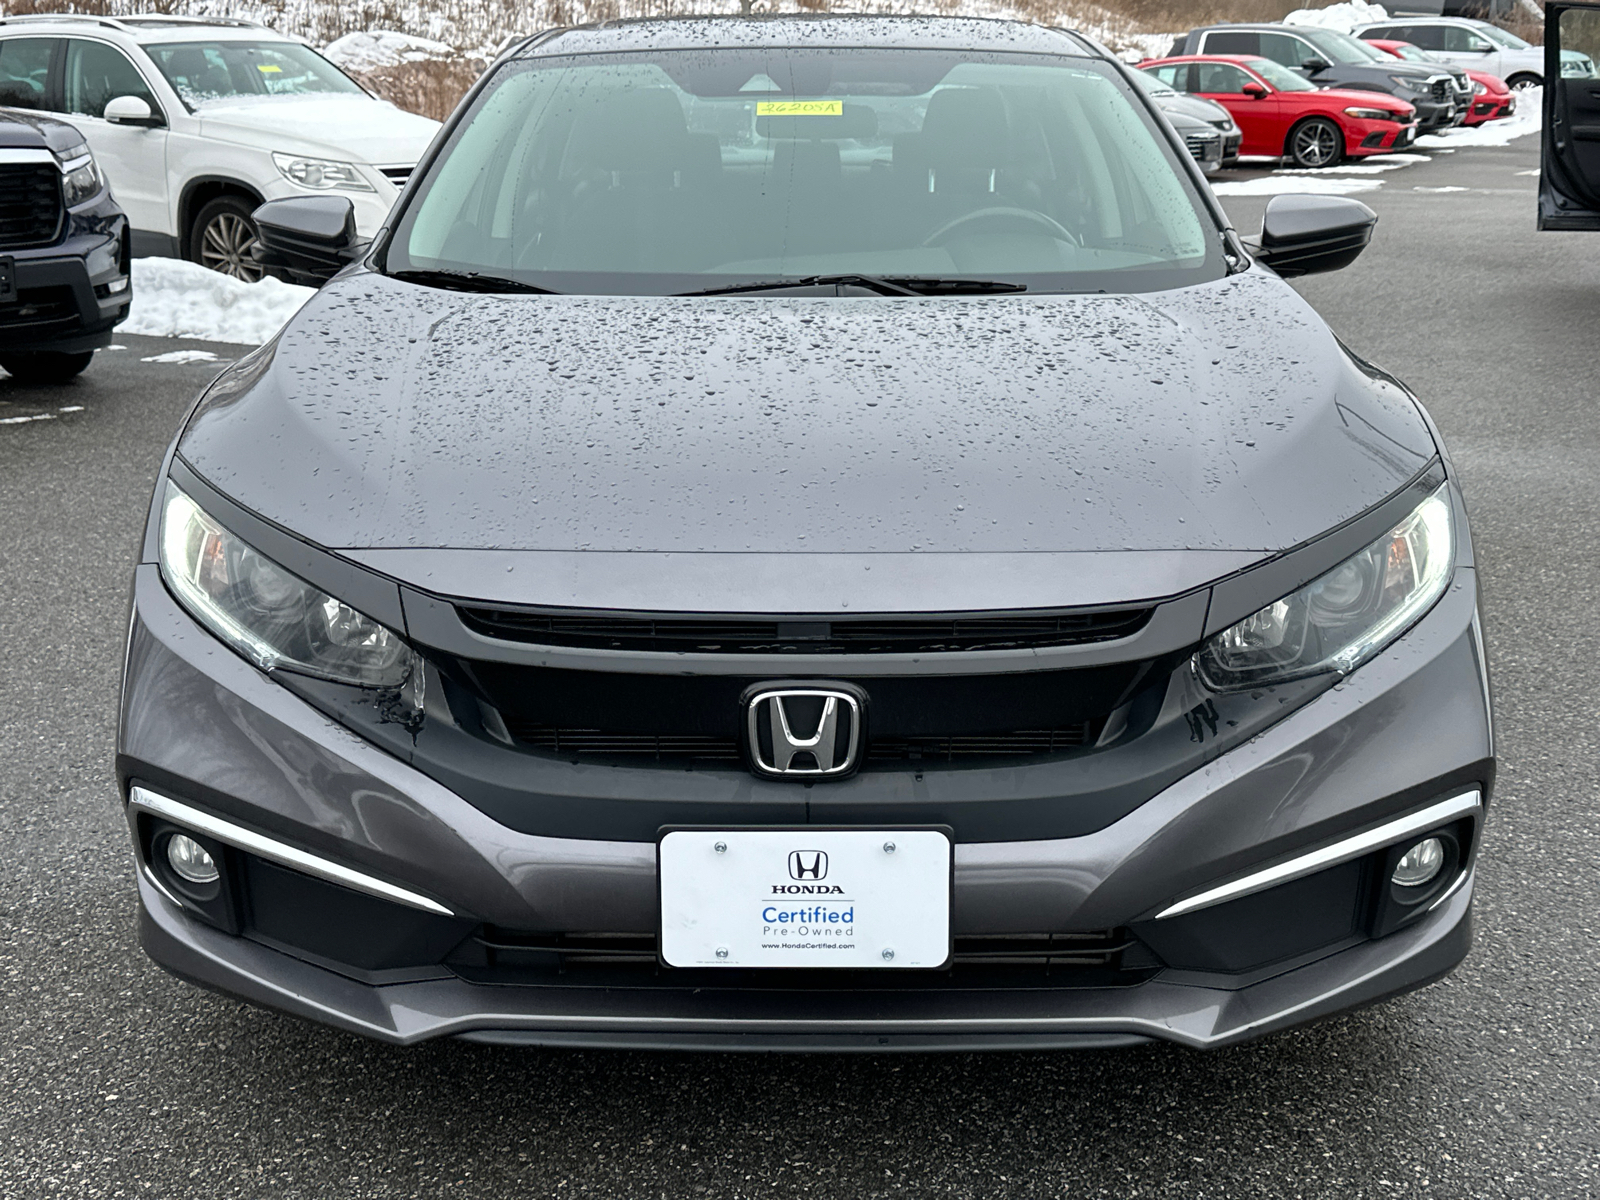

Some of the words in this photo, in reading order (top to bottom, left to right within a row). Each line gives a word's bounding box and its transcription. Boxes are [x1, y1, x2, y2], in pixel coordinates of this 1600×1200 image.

[771, 885, 845, 894] HONDA
[762, 906, 854, 923] Certified
[763, 926, 853, 936] Pre-Owned
